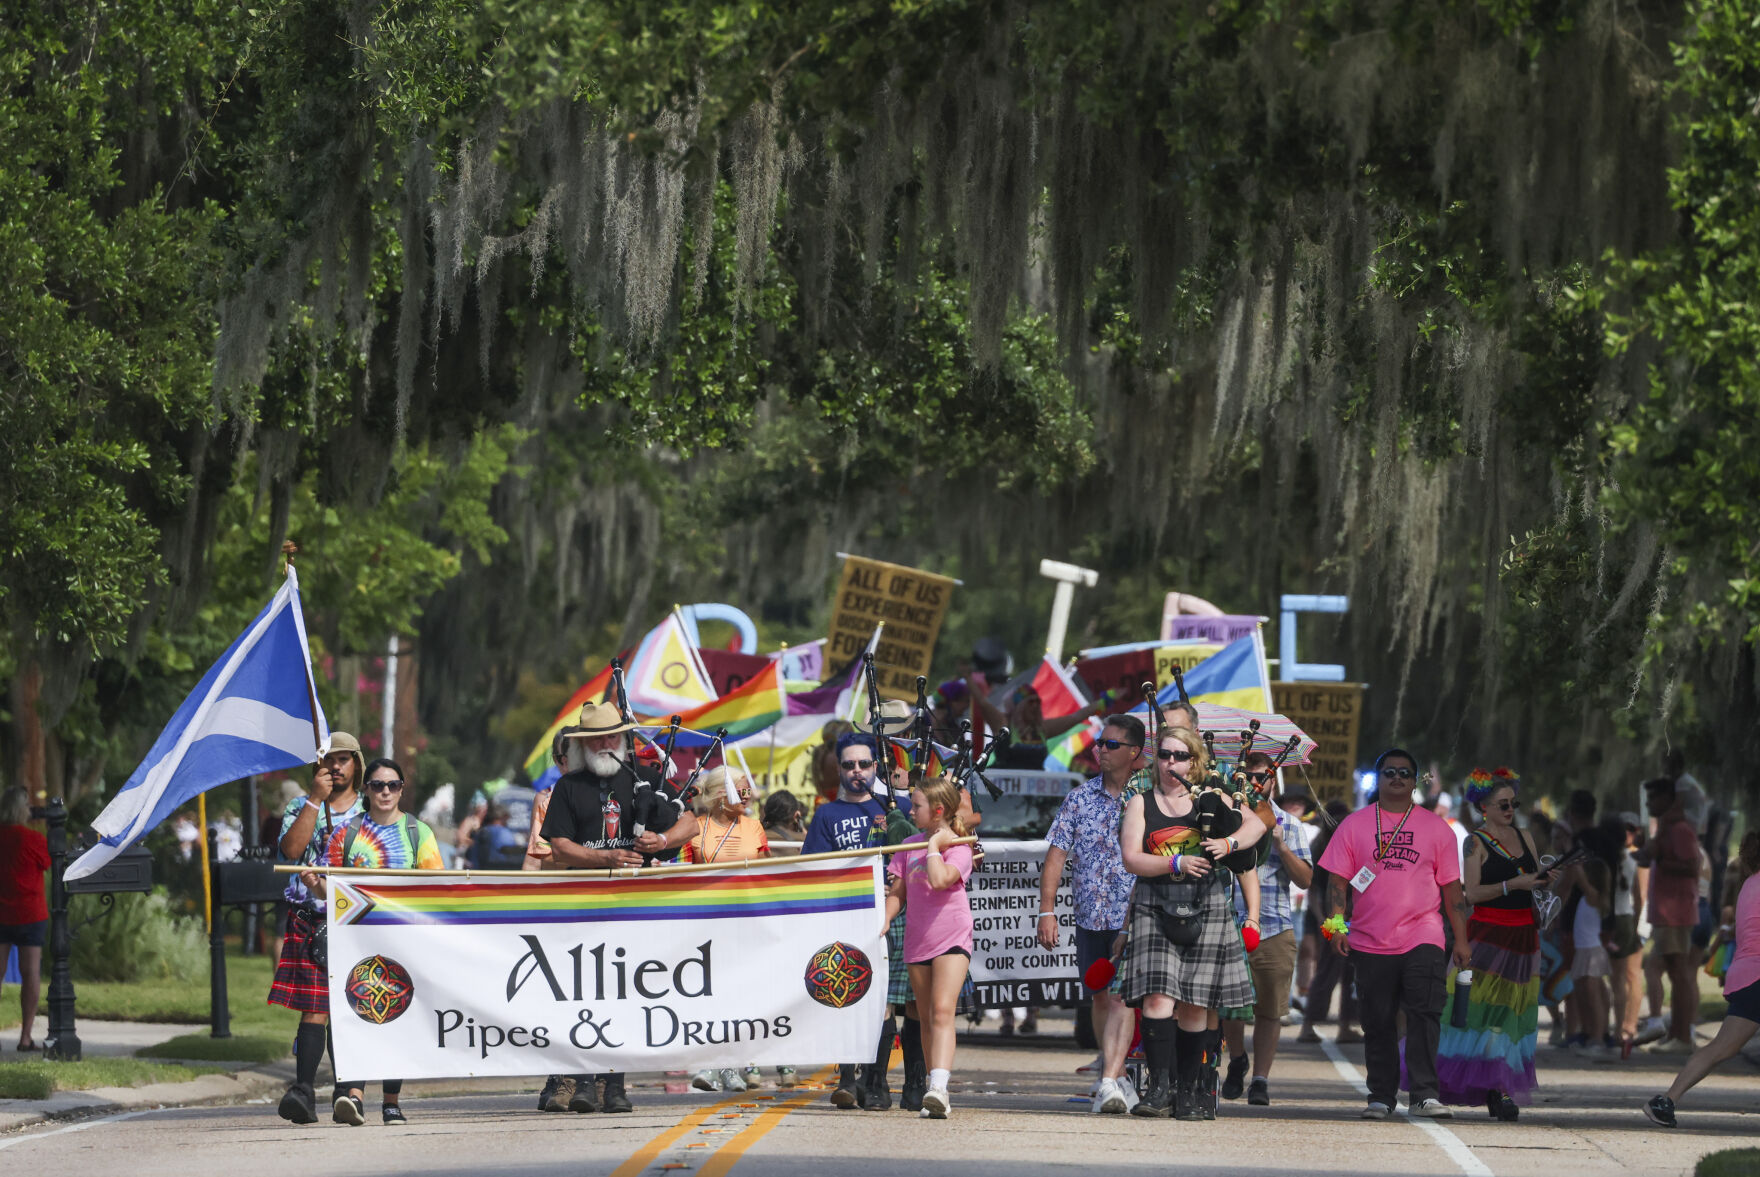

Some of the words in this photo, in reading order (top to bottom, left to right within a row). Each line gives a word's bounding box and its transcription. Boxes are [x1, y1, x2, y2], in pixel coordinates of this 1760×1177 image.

[847, 566, 883, 593] ALL
[889, 575, 914, 598] OF
[915, 580, 943, 606] US
[842, 591, 936, 628] EXPERIENCE
[837, 613, 929, 644] DISCRIINATION
[877, 641, 924, 671] BEING
[1273, 690, 1295, 711] LL
[1301, 691, 1322, 711] OF
[1328, 691, 1353, 713] US
[834, 822, 839, 836] I
[841, 815, 869, 831] PUT
[835, 830, 861, 848] THE
[1372, 846, 1420, 864] CPTAIN
[979, 877, 1040, 891] DEFIANC
[973, 915, 1022, 932] GOTRY
[507, 934, 713, 1003] Allied
[985, 956, 1015, 970] OUR
[1021, 953, 1079, 968] COUNTR
[1041, 981, 1084, 1001] WIT
[435, 1009, 550, 1059] Pipes
[569, 1009, 623, 1050] &
[642, 1005, 792, 1048] Drums
